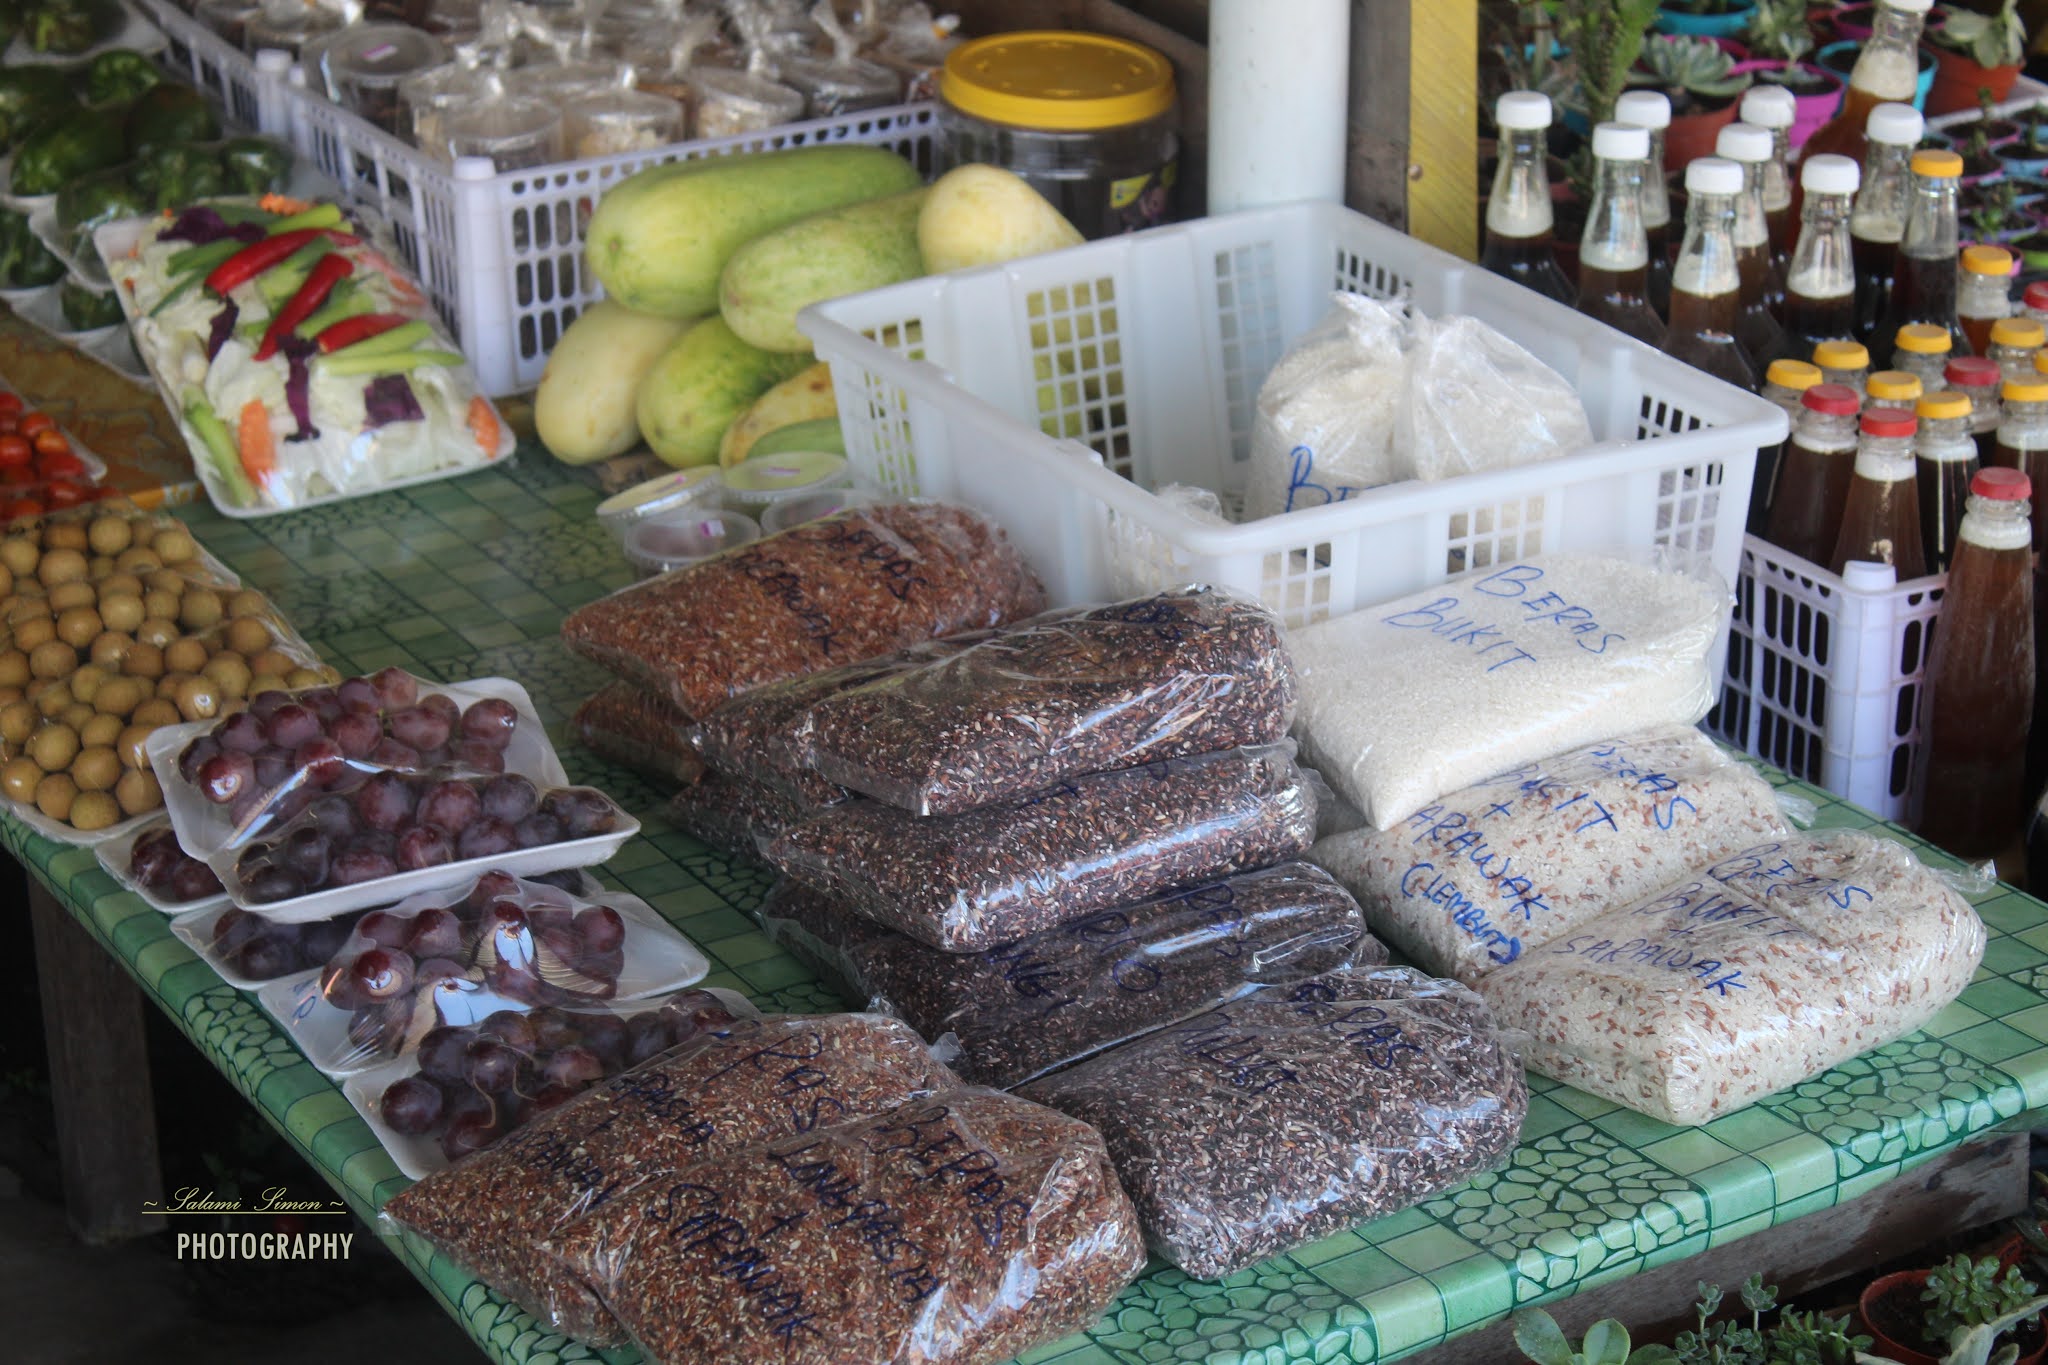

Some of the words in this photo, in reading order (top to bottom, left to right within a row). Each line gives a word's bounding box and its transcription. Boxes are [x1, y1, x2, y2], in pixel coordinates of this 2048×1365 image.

[1380, 596, 1538, 672] BUKIT
[1473, 564, 1627, 655] BERAS
[1551, 934, 1748, 997] SARAWAK
